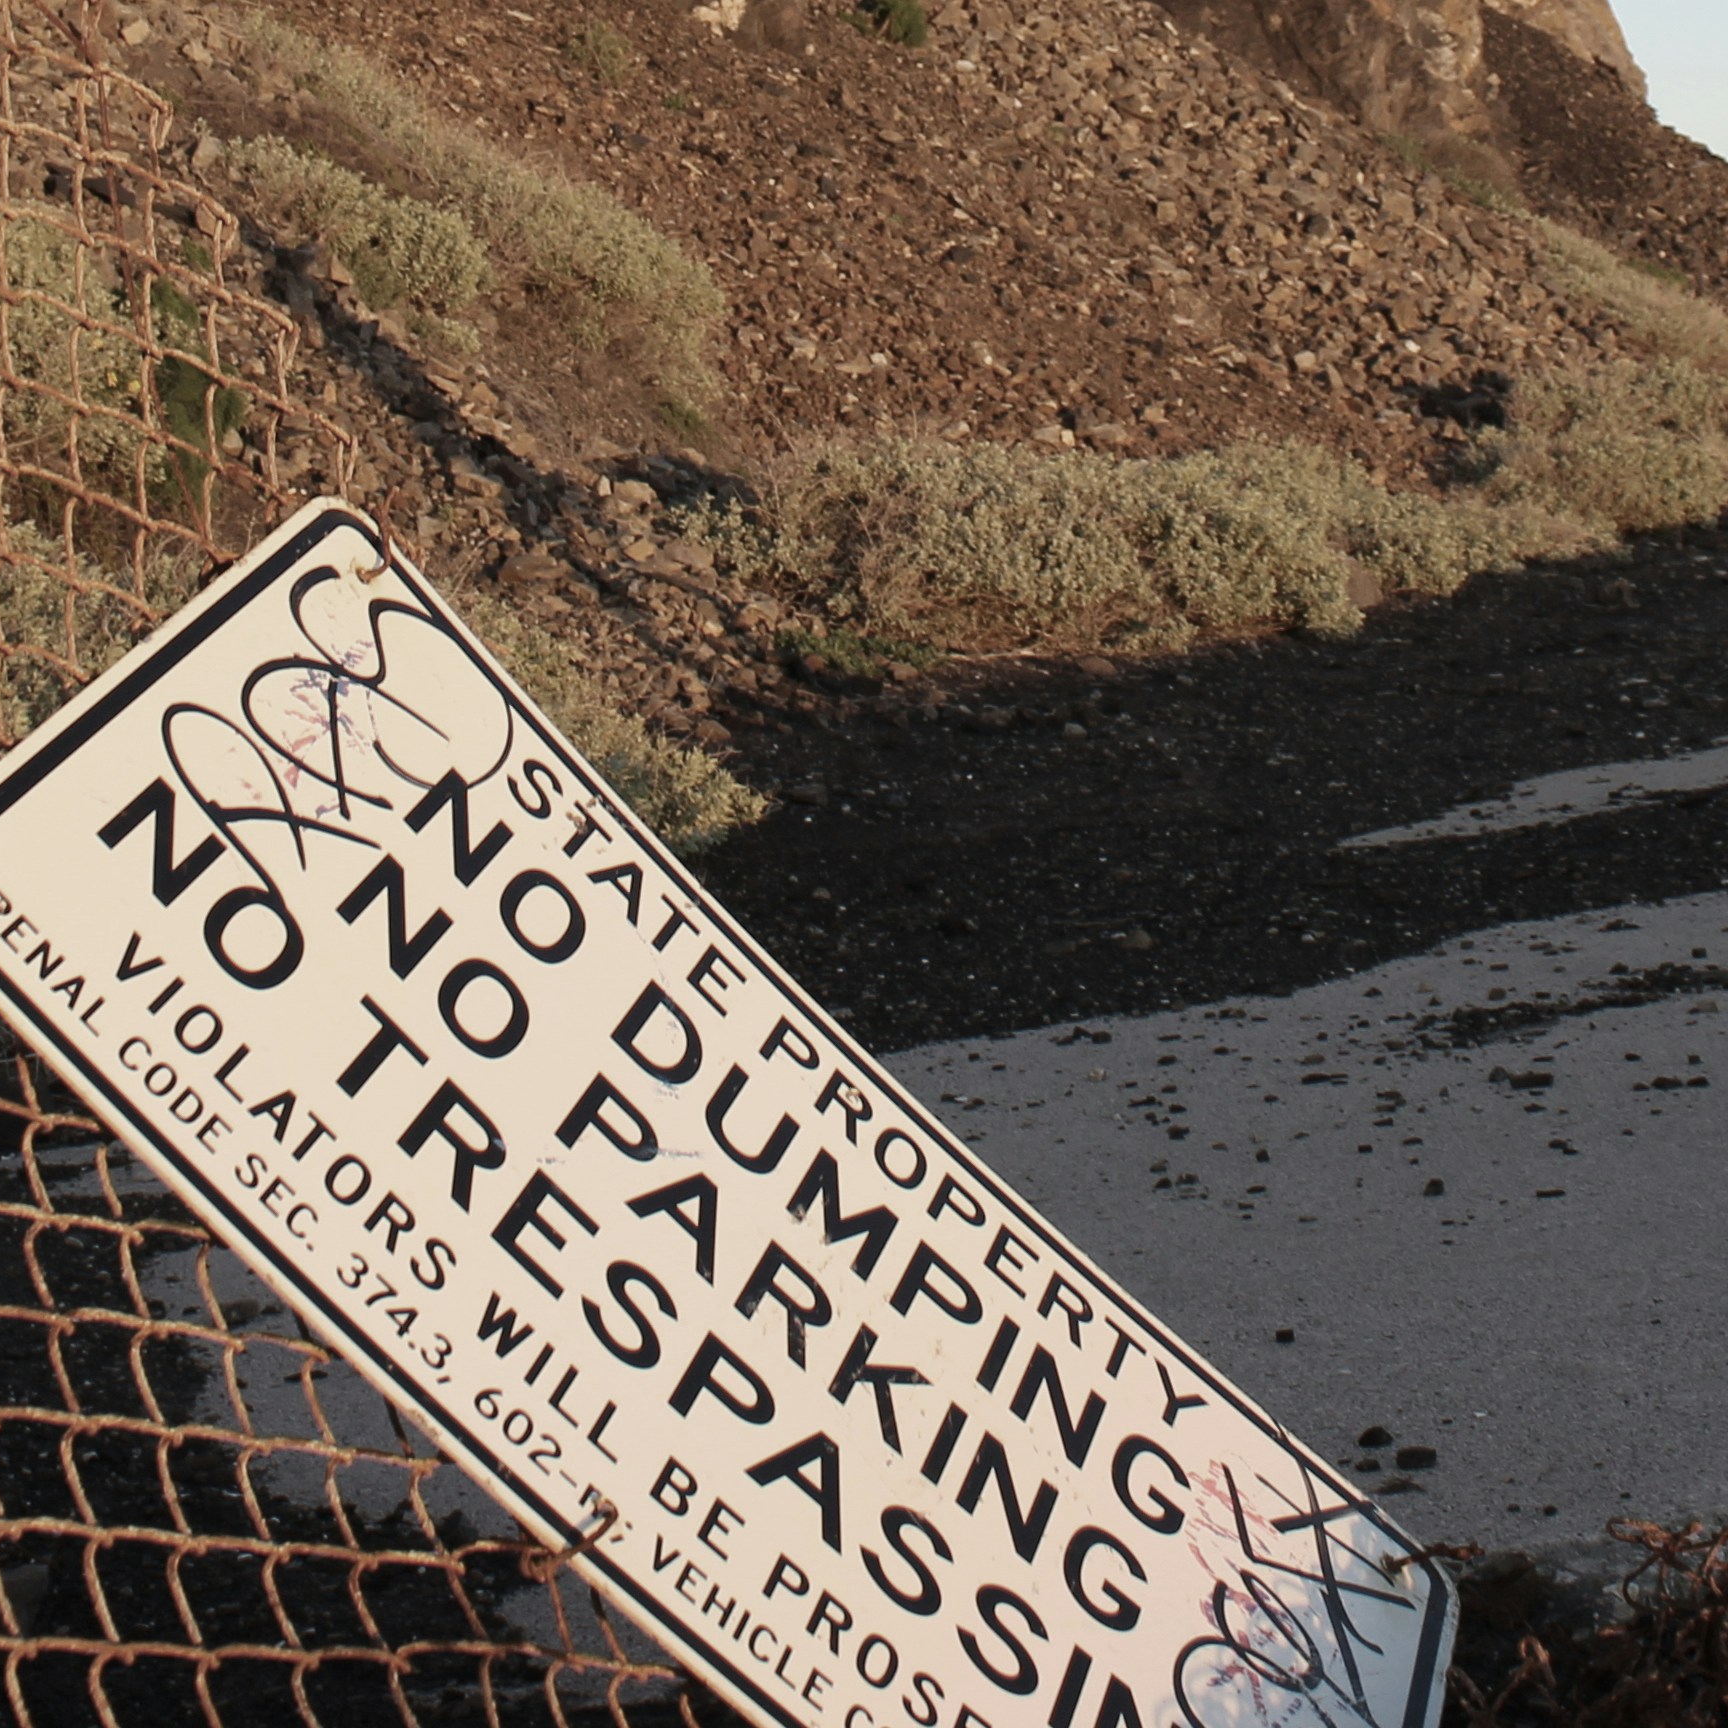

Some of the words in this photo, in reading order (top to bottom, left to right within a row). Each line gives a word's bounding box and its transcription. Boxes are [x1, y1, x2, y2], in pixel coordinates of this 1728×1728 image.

[96, 776, 305, 991] NO
[404, 766, 587, 965] NO
[610, 979, 1191, 1536] DUMPING
[507, 758, 746, 1017] STATE
[759, 1015, 1209, 1427] PROPERTY
[114, 930, 457, 1291] VIOLATORS
[476, 1290, 619, 1464] WILL
[649, 1455, 747, 1562] BE
[118, 1035, 233, 1154] CODE
[234, 1153, 318, 1252] SEC.
[336, 1252, 454, 1385] 374.3,
[651, 1533, 834, 1712] VEHICLE
[335, 853, 530, 1060] NO
[554, 1072, 1148, 1633] PARKING
